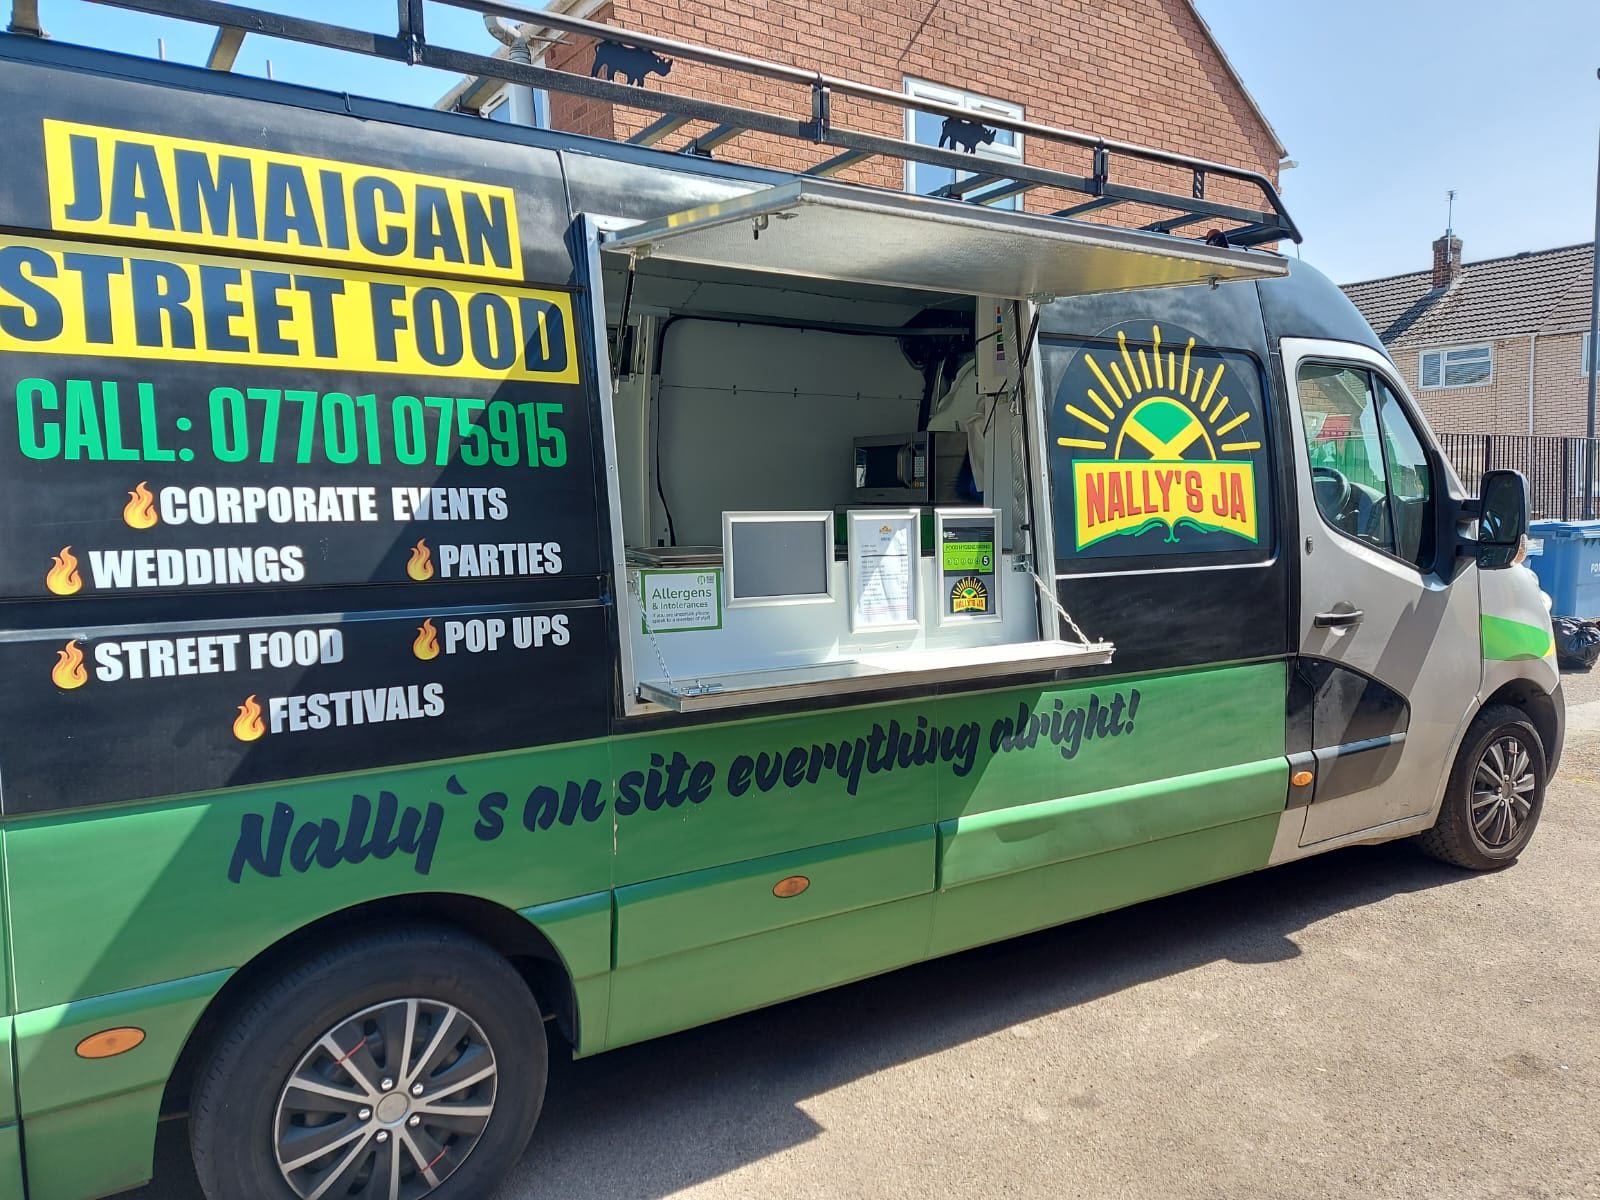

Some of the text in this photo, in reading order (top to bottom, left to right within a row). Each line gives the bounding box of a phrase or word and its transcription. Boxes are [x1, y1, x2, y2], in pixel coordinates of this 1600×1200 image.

[65, 134, 514, 269] JAMAICAN
[0, 246, 569, 372] STREET FOOD
[16, 378, 568, 468] CALL: 07701 075915
[159, 486, 509, 525] CORPORATE EVENTS
[1086, 470, 1247, 527] NALLY'S JA
[88, 546, 305, 589] WEDDINGS
[439, 542, 563, 578] PARTIES
[652, 587, 712, 601] Allergens
[652, 601, 708, 610] & Intolerances
[94, 628, 344, 682] STREET FOOD
[444, 614, 570, 655] POP UPS
[269, 682, 445, 734] FESTIVALS
[523, 778, 606, 832] on
[614, 751, 716, 816] site
[727, 715, 980, 796] everything
[990, 688, 1141, 760] alright!
